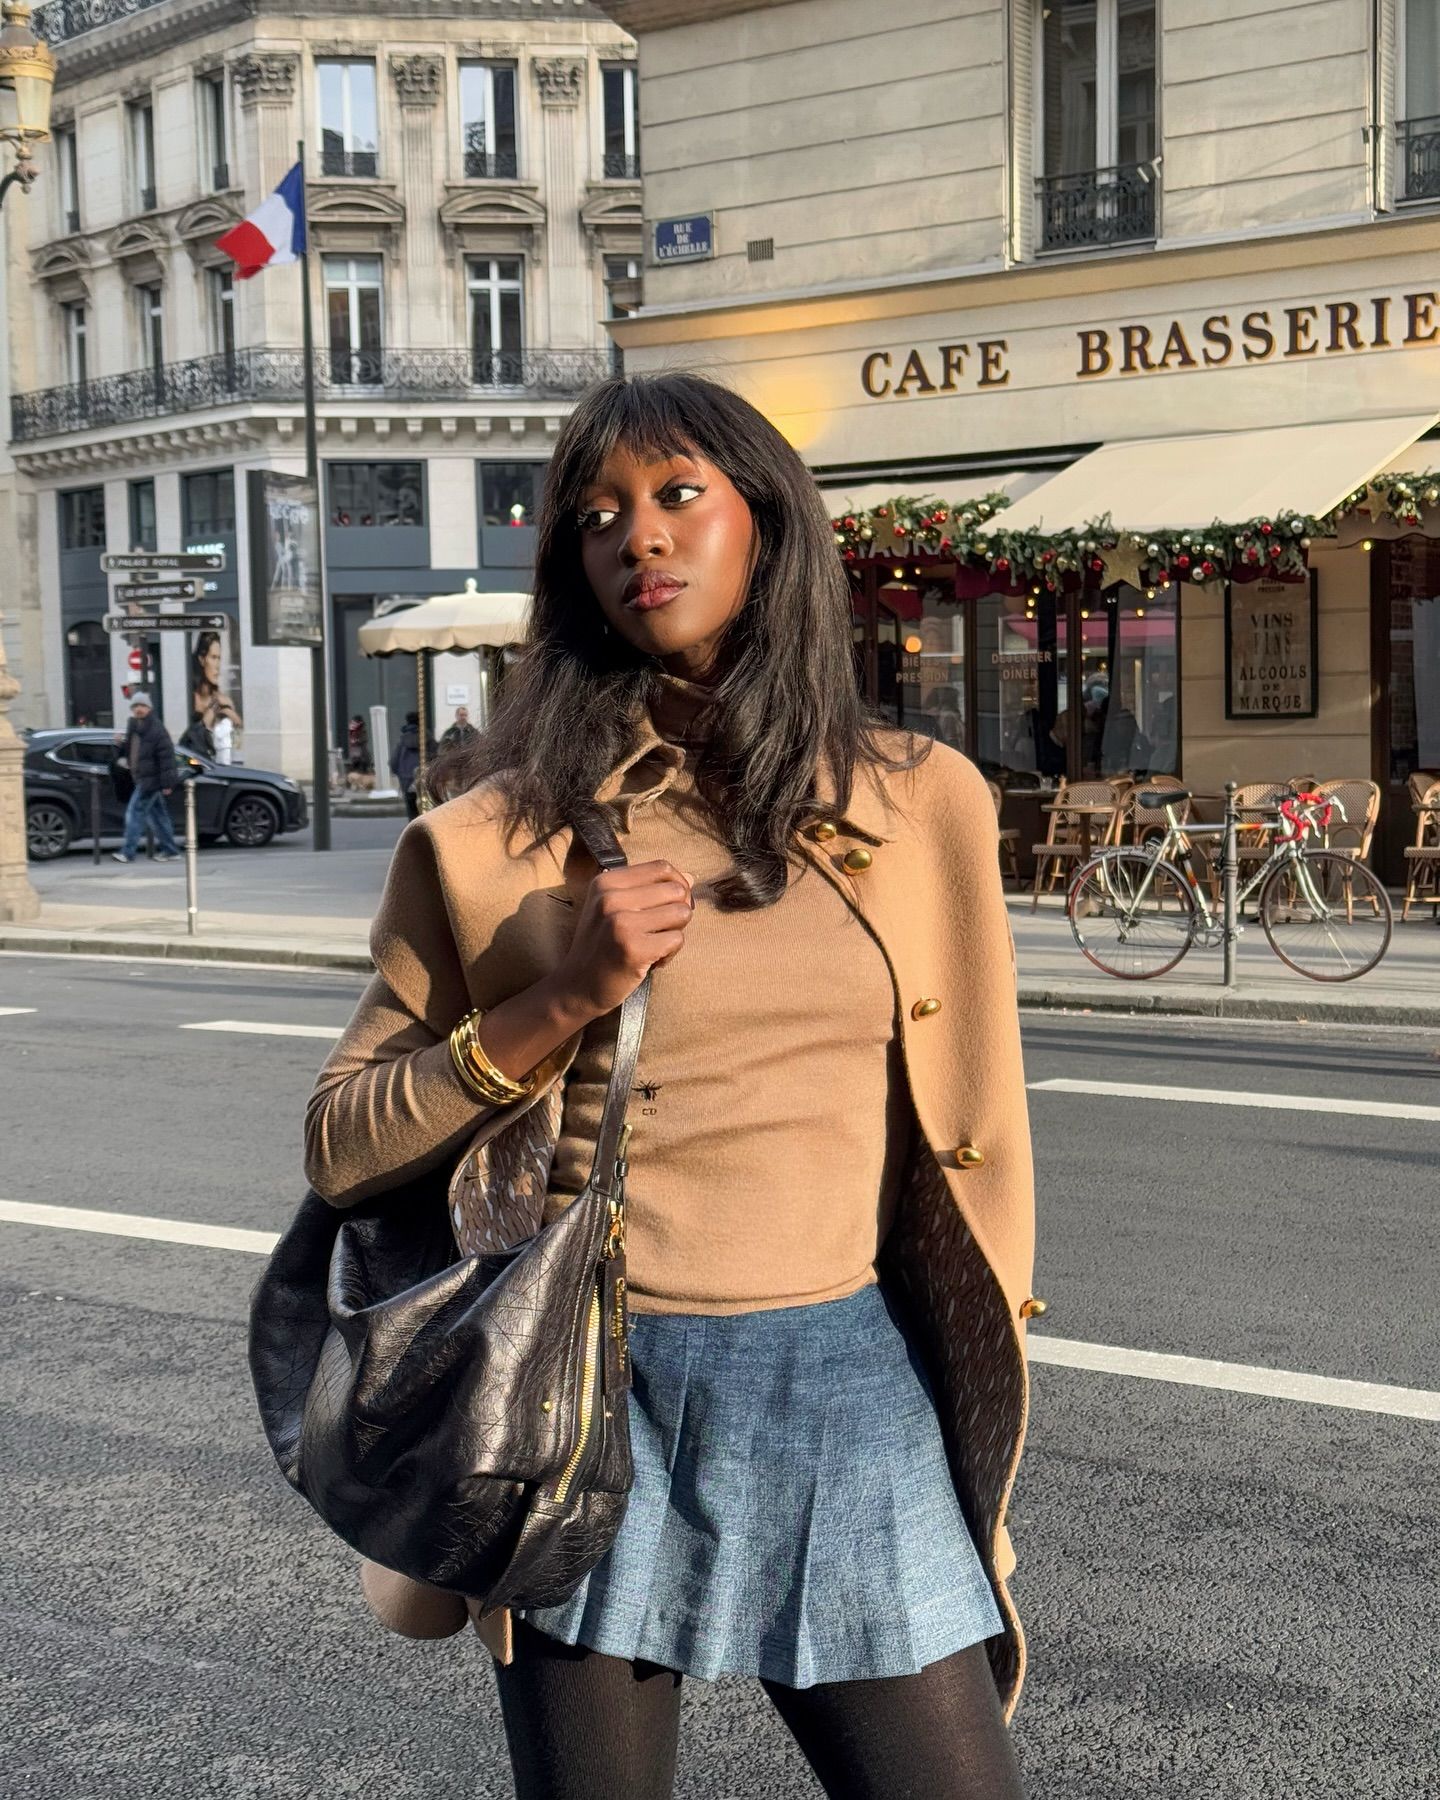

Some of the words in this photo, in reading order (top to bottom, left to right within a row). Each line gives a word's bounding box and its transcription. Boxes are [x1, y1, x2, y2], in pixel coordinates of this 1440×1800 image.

[673, 222, 693, 234] RUE
[676, 234, 689, 245] DE
[861, 339, 1010, 399] CAFE
[1076, 291, 1440, 378] BRASSERIE
[118, 558, 148, 567] PALAIS
[152, 558, 179, 567] ROYAL
[1251, 612, 1293, 629] VINS
[896, 671, 949, 684] PRESSION
[1240, 665, 1307, 681] ALCOOLS
[1262, 683, 1280, 692] DE
[1240, 695, 1302, 712] MARQUE
[641, 1107, 657, 1116] CD
